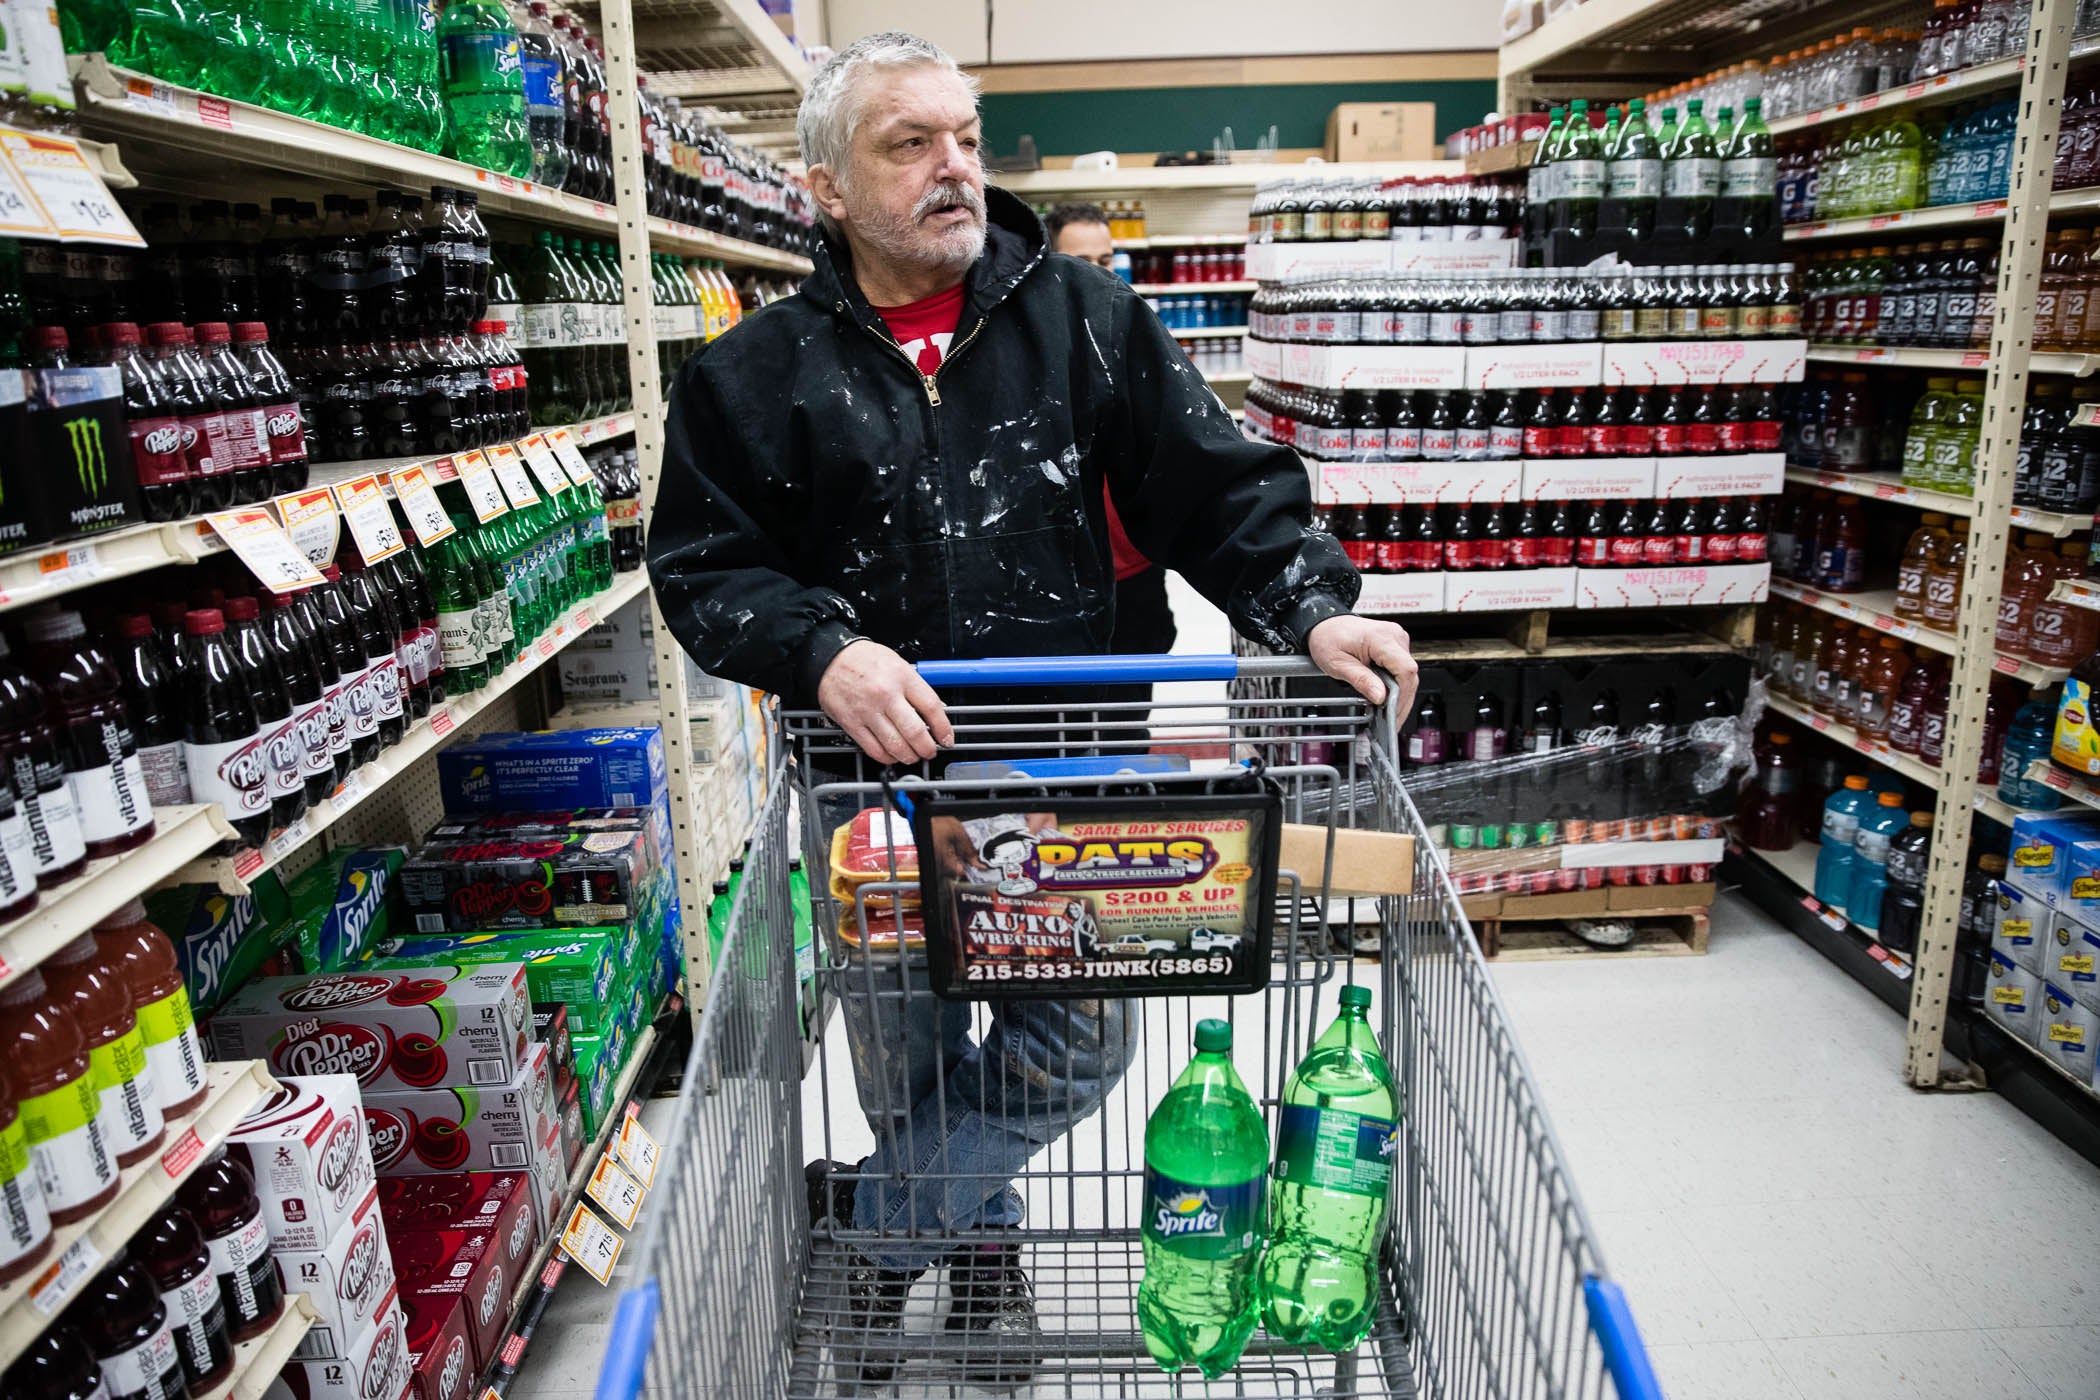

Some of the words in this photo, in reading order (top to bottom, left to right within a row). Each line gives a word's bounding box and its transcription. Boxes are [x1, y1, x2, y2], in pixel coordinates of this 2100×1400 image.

[1783, 184, 1796, 201] G
[1836, 300, 1850, 318] G
[1854, 299, 1867, 318] G
[1947, 298, 1975, 316] G2
[1933, 445, 1960, 465] G2
[71, 502, 125, 525] MONSTER
[1927, 581, 1955, 603] G2
[2033, 611, 2063, 635] G2
[565, 670, 627, 688] Seagram's
[1793, 663, 1805, 682] G
[1816, 670, 1830, 691] G
[1837, 680, 1849, 700] G
[1859, 692, 1873, 713] G
[2065, 709, 2084, 723] Lipton
[511, 766, 552, 775] PERFECTLY
[534, 758, 540, 766] A
[541, 757, 568, 766] SPRITE
[102, 720, 138, 827] vitaminwater
[14, 754, 55, 867] vitaminwater
[1072, 823, 1123, 837] SAME
[1128, 822, 1161, 835] DAY
[1165, 819, 1248, 834] SERVICES
[1037, 841, 1206, 880] PATS
[2016, 851, 2052, 864] Schweppes
[961, 892, 995, 904] FINAL
[997, 896, 1068, 908] DESTINATION
[1105, 890, 1169, 906] $200
[1177, 890, 1193, 903] &
[1203, 887, 1236, 901] UP
[2046, 891, 2056, 906] 12
[345, 868, 386, 957] Sprite
[502, 915, 526, 924] cherry
[1099, 908, 1123, 917] FOR
[1126, 906, 1181, 916] RUNNING
[1185, 904, 1240, 913] VEHICLES
[967, 911, 1069, 934] AUTO
[1100, 917, 1130, 925] Highest
[197, 893, 254, 1000] Sprite
[969, 931, 1073, 947] WRECKING
[522, 943, 589, 961] Sprite
[967, 957, 1233, 981] 215-533-JUNK(5865)
[308, 975, 347, 987] Diet
[334, 981, 368, 992] Dr
[299, 982, 386, 1007] Pepper
[480, 1008, 496, 1019] 12
[285, 1017, 320, 1043] Diet
[458, 1026, 498, 1038] cherry
[170, 997, 200, 1091] vitaminwater
[320, 1034, 353, 1053] Dr
[302, 1041, 376, 1075] Pepper
[112, 1041, 148, 1142] vitaminwater
[503, 1093, 516, 1104] 12
[481, 1111, 520, 1121] cherry
[76, 1080, 111, 1185] vitaminwater
[289, 1201, 296, 1211] 0
[1155, 1207, 1218, 1237] Sprite
[226, 1238, 259, 1321] vitaminwater
[301, 1263, 319, 1277] 12
[180, 1287, 213, 1375] vitaminwater
[325, 1366, 343, 1380] 12
